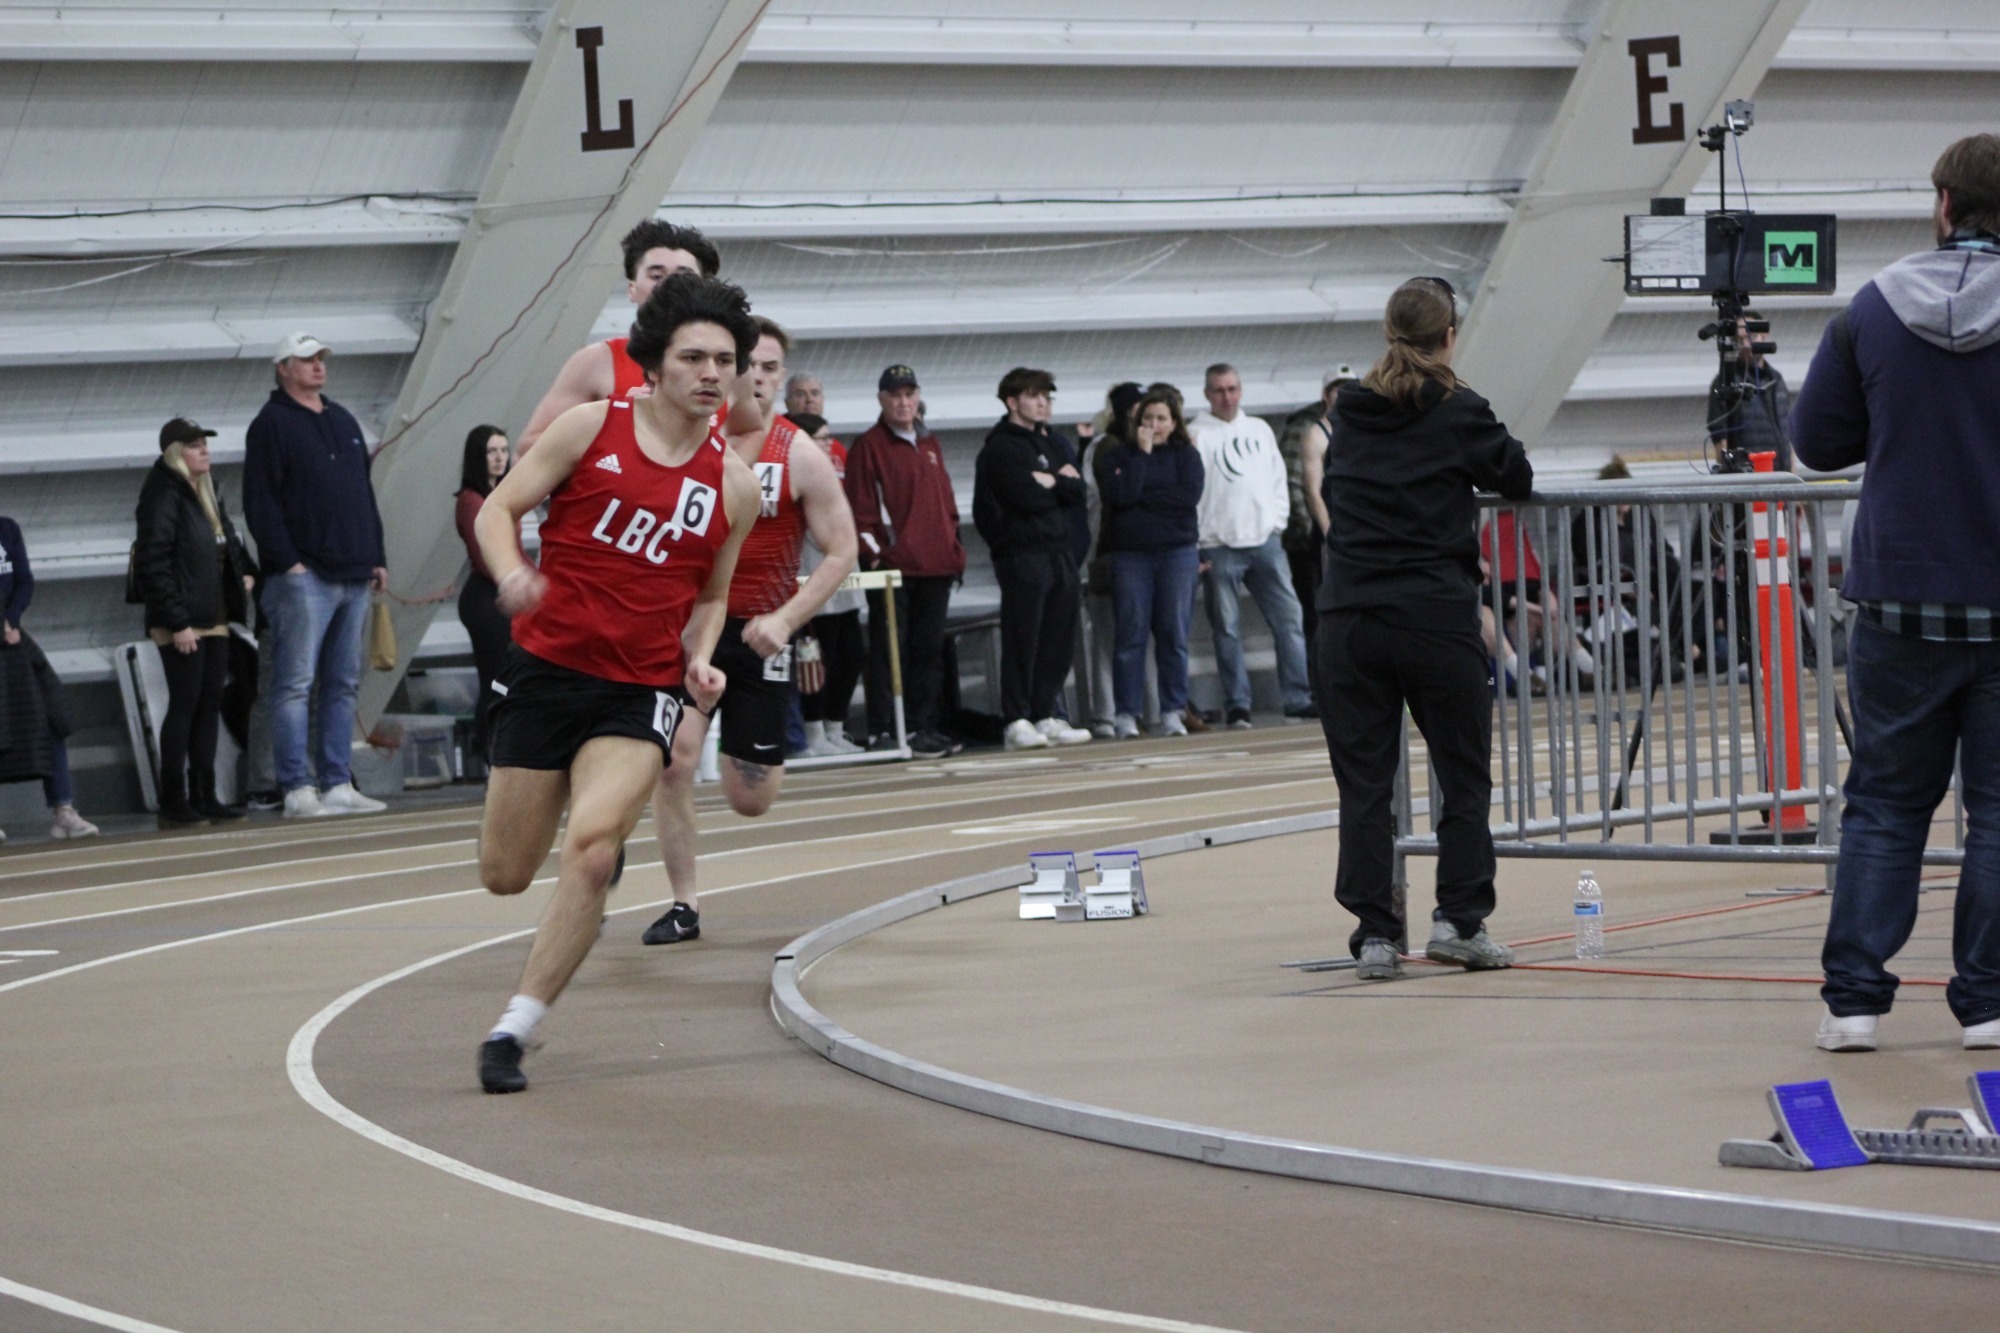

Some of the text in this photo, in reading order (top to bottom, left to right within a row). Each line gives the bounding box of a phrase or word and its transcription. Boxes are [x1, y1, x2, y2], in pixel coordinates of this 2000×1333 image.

[576, 26, 635, 152] L
[1628, 35, 1686, 145] E
[1769, 243, 1813, 267] M
[595, 460, 622, 474] adidas
[760, 465, 774, 498] 4
[683, 485, 708, 528] 6
[591, 498, 683, 565] LBC
[661, 697, 675, 737] 6
